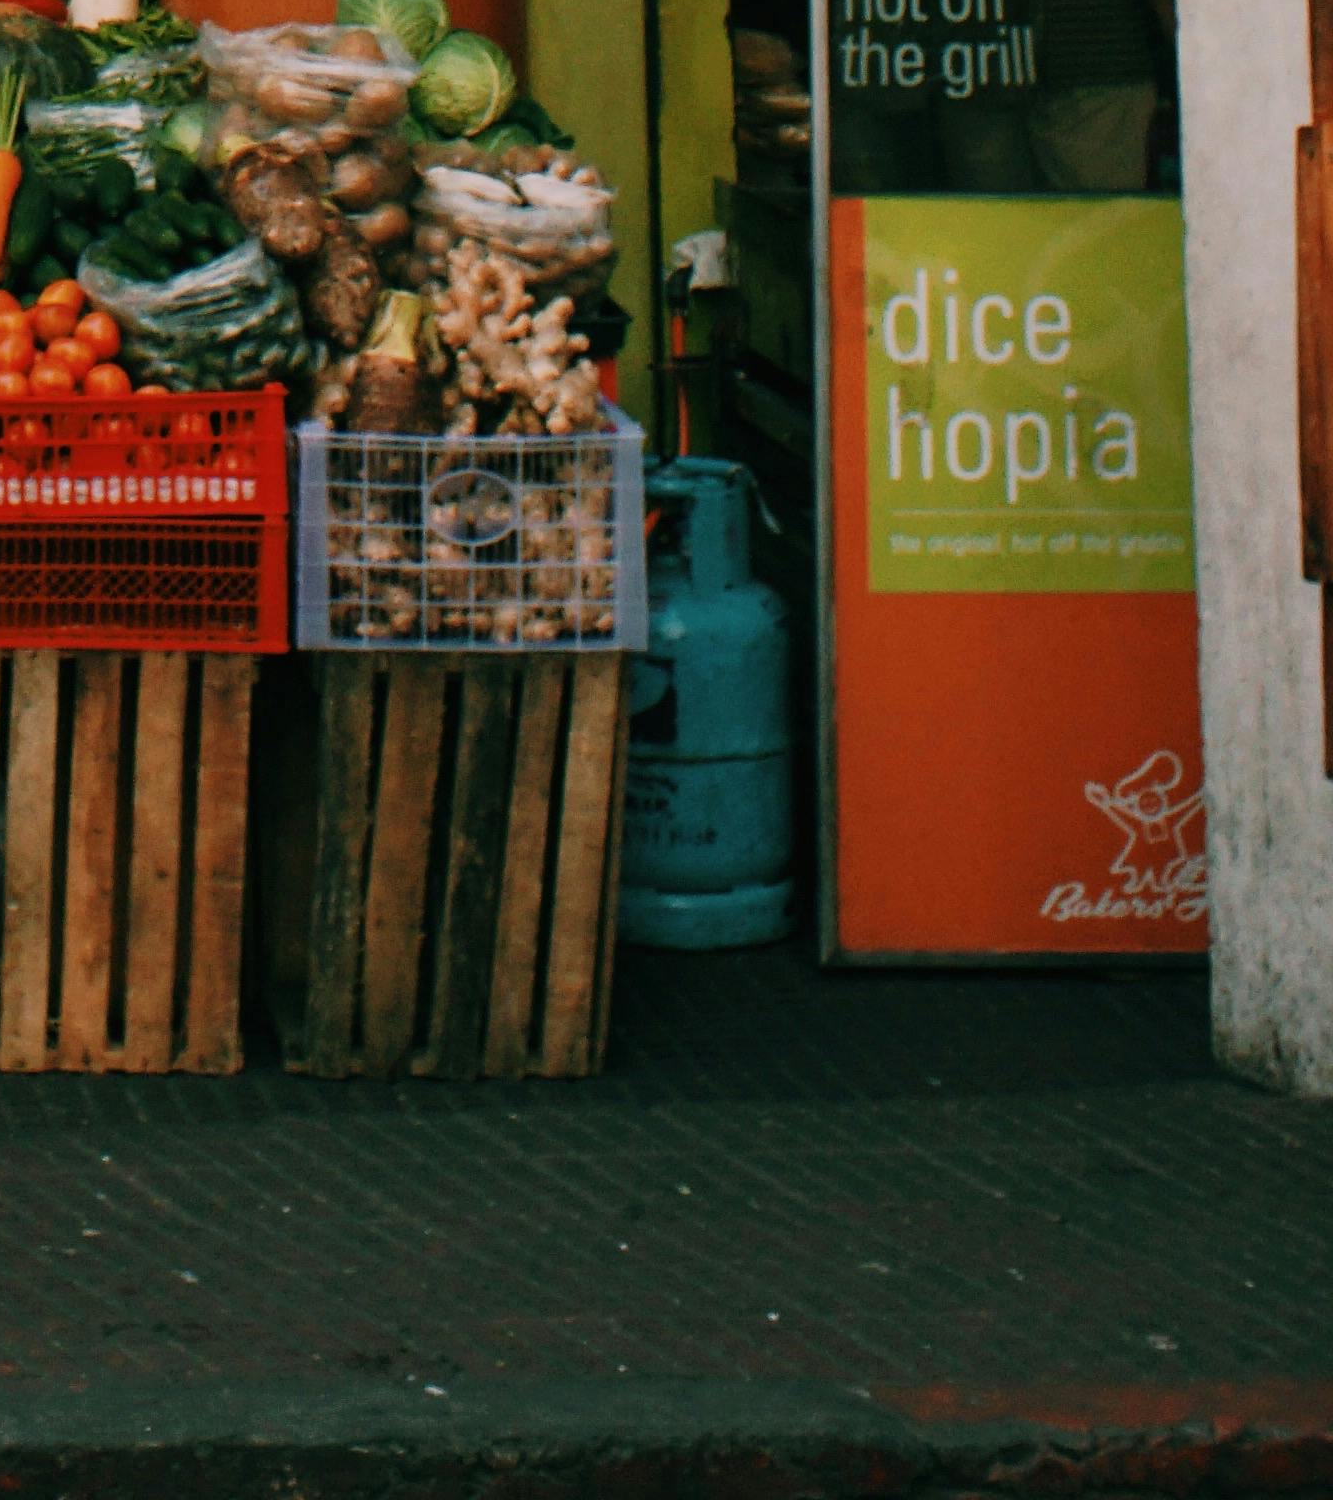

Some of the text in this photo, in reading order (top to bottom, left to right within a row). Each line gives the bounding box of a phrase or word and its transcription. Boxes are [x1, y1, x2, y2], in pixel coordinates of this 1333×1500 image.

[839, 24, 1036, 99] the grill
[881, 266, 1072, 366] dice
[886, 383, 1140, 505] hopia
